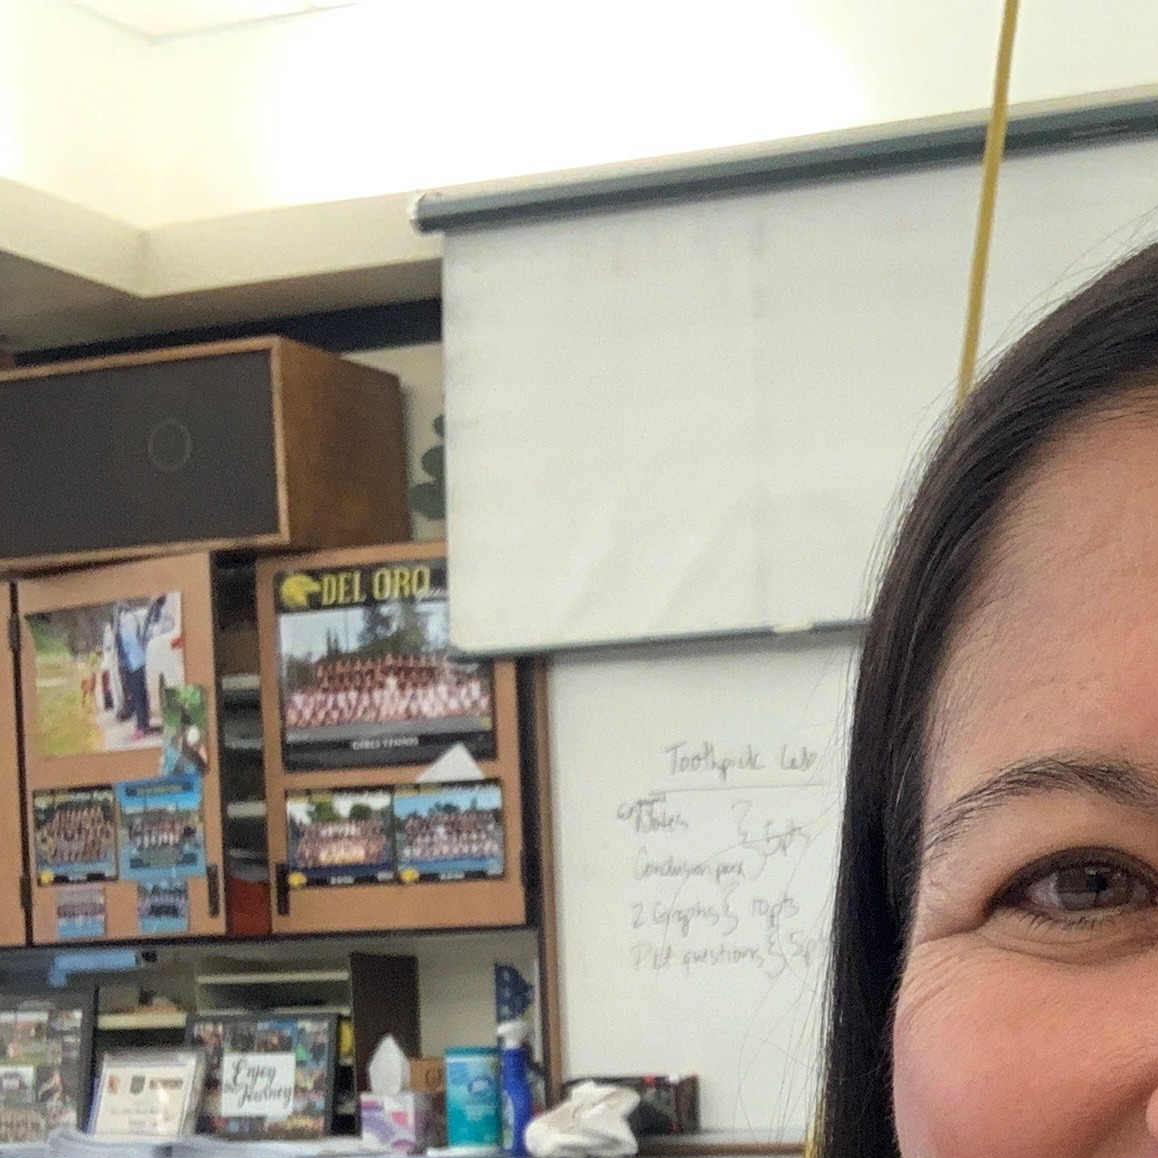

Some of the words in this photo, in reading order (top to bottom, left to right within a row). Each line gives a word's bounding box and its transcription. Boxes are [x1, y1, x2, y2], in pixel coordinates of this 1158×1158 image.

[322, 570, 366, 606] DEL
[373, 565, 431, 600] ORO
[632, 902, 645, 929] 2
